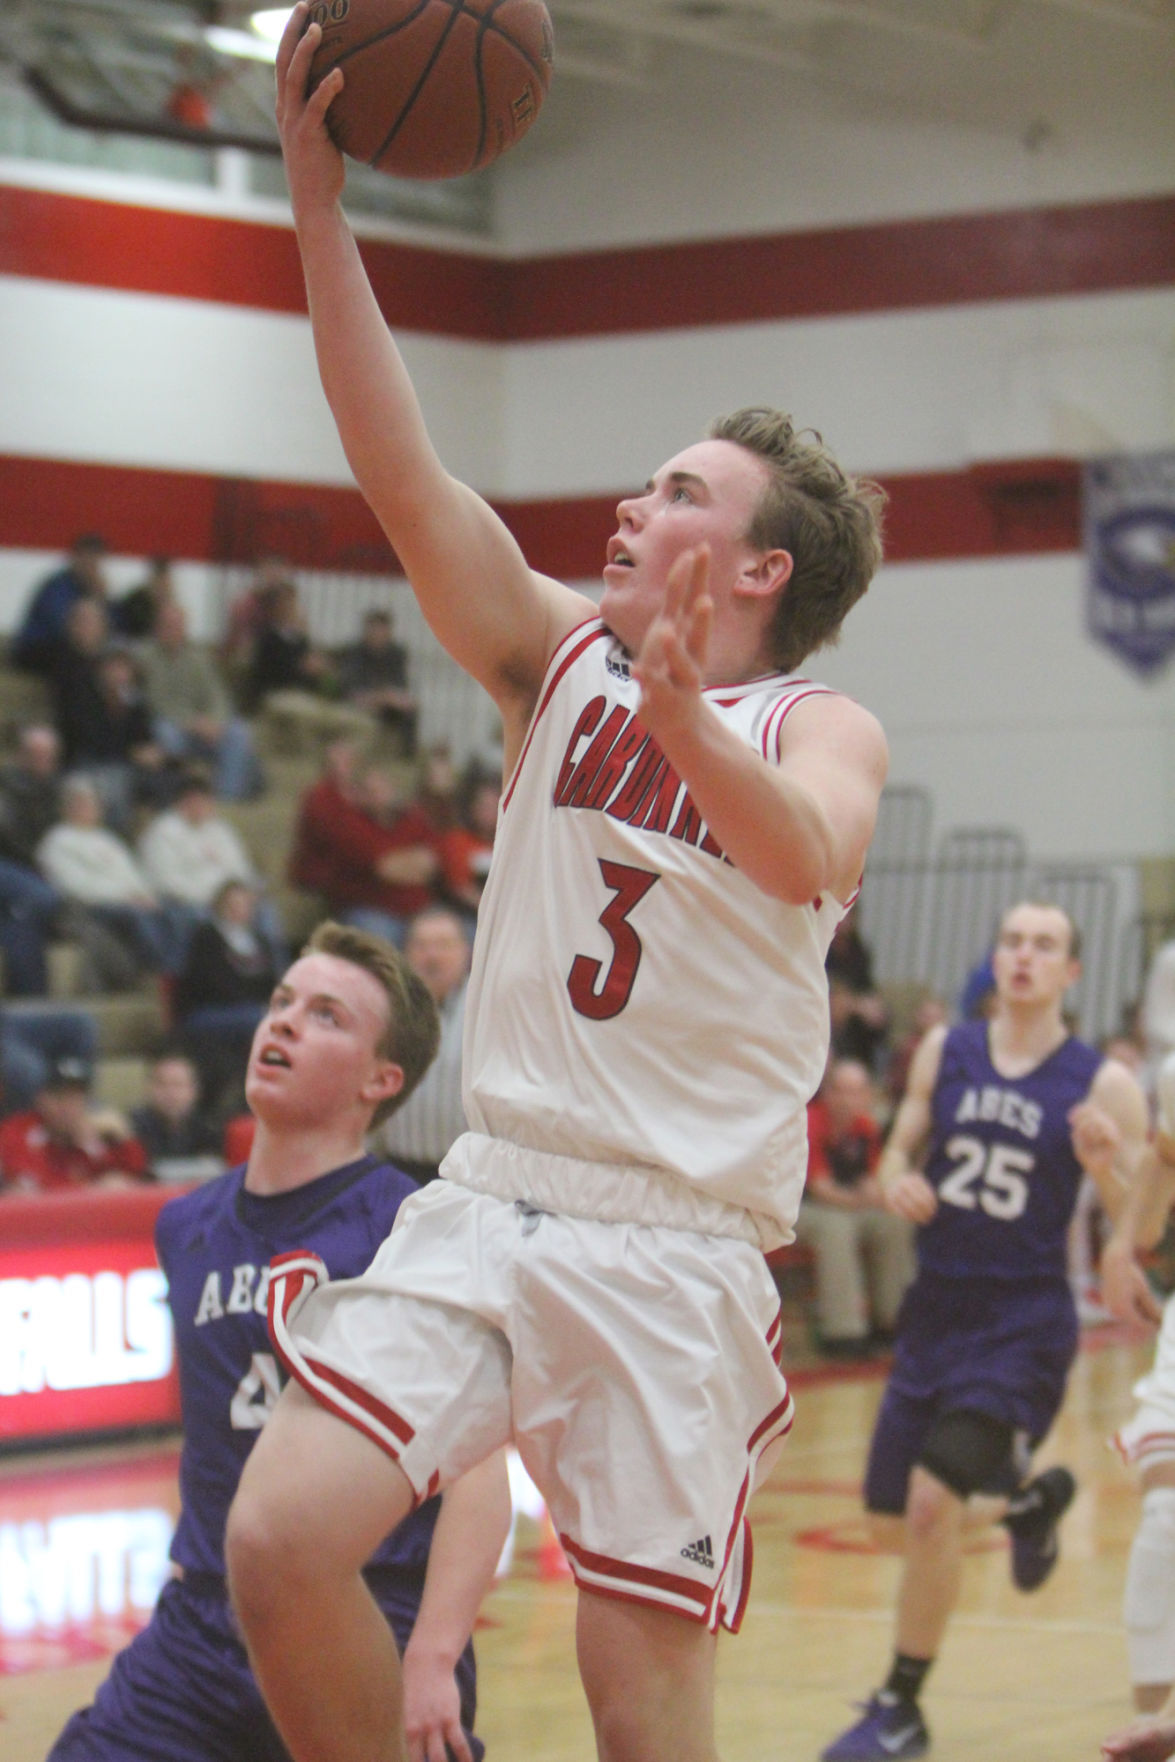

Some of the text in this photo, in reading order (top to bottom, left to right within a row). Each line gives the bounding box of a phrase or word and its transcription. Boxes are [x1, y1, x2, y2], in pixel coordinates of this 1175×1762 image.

[567, 857, 661, 1021] 3
[955, 1085, 1043, 1139] ABES
[938, 1136, 1035, 1221] 25
[231, 1351, 281, 1430] 4
